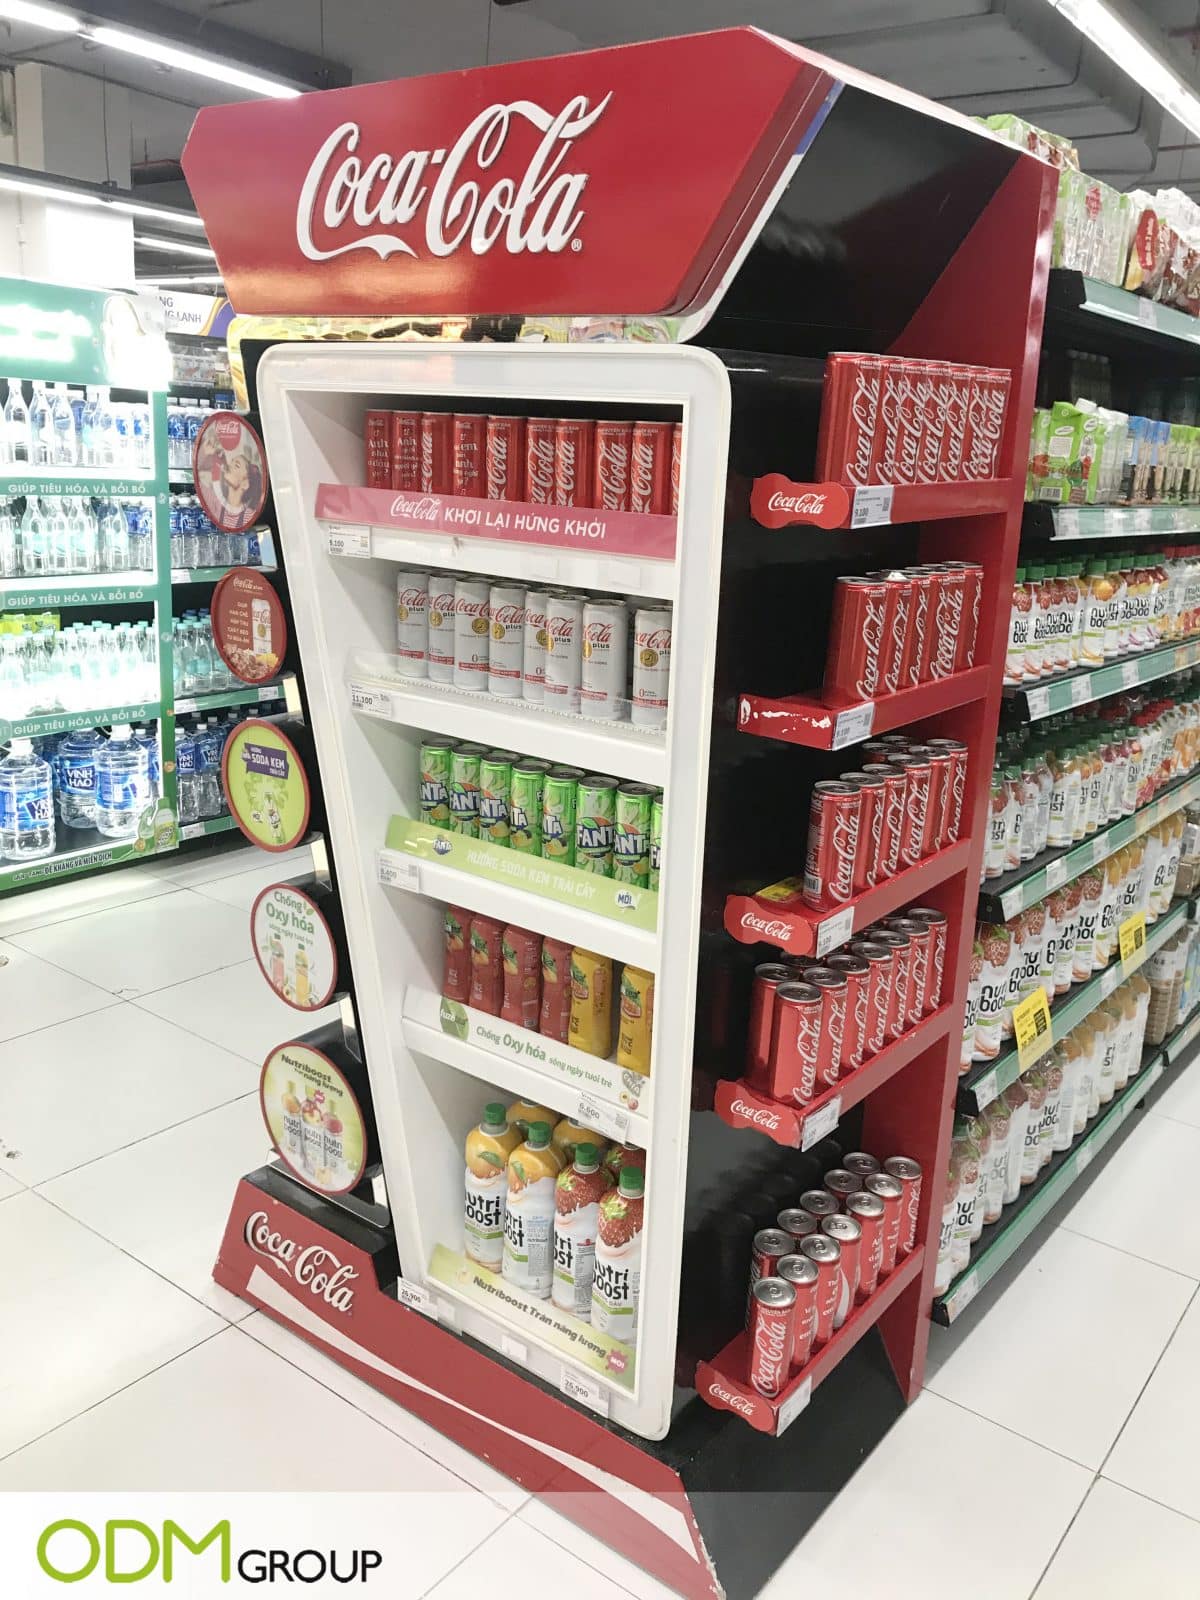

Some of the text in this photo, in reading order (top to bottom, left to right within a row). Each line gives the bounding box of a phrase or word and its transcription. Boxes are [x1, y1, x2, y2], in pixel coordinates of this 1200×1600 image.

[296, 91, 614, 260] Coca-Cola
[390, 495, 607, 540] Coca-Cola KHƠI LẠI HỨNG KHỞI
[768, 491, 828, 514] Coca-Cola
[14, 724, 40, 735] GIÚP
[252, 754, 270, 766] SODA
[270, 758, 285, 770] KEM
[577, 823, 614, 848] FANT
[500, 859, 527, 880] SODA
[529, 867, 550, 886] KEM
[829, 811, 861, 903] Coca-Cola
[266, 902, 314, 934] Oxy hóa
[274, 890, 303, 914] Chống
[741, 912, 793, 941] Coca-Cola
[476, 1026, 501, 1046] Chống
[503, 1034, 524, 1054] Oxy
[526, 1043, 546, 1060] hóa
[281, 1054, 332, 1082] Nutriboost
[730, 1099, 783, 1131] Coca-Cola
[466, 1206, 502, 1226] oost
[245, 1211, 359, 1311] Coca-Cola
[474, 1276, 528, 1312] Nutriboost
[752, 1312, 787, 1397] Coca-Cola
[708, 1382, 757, 1417] Coca-Cola
